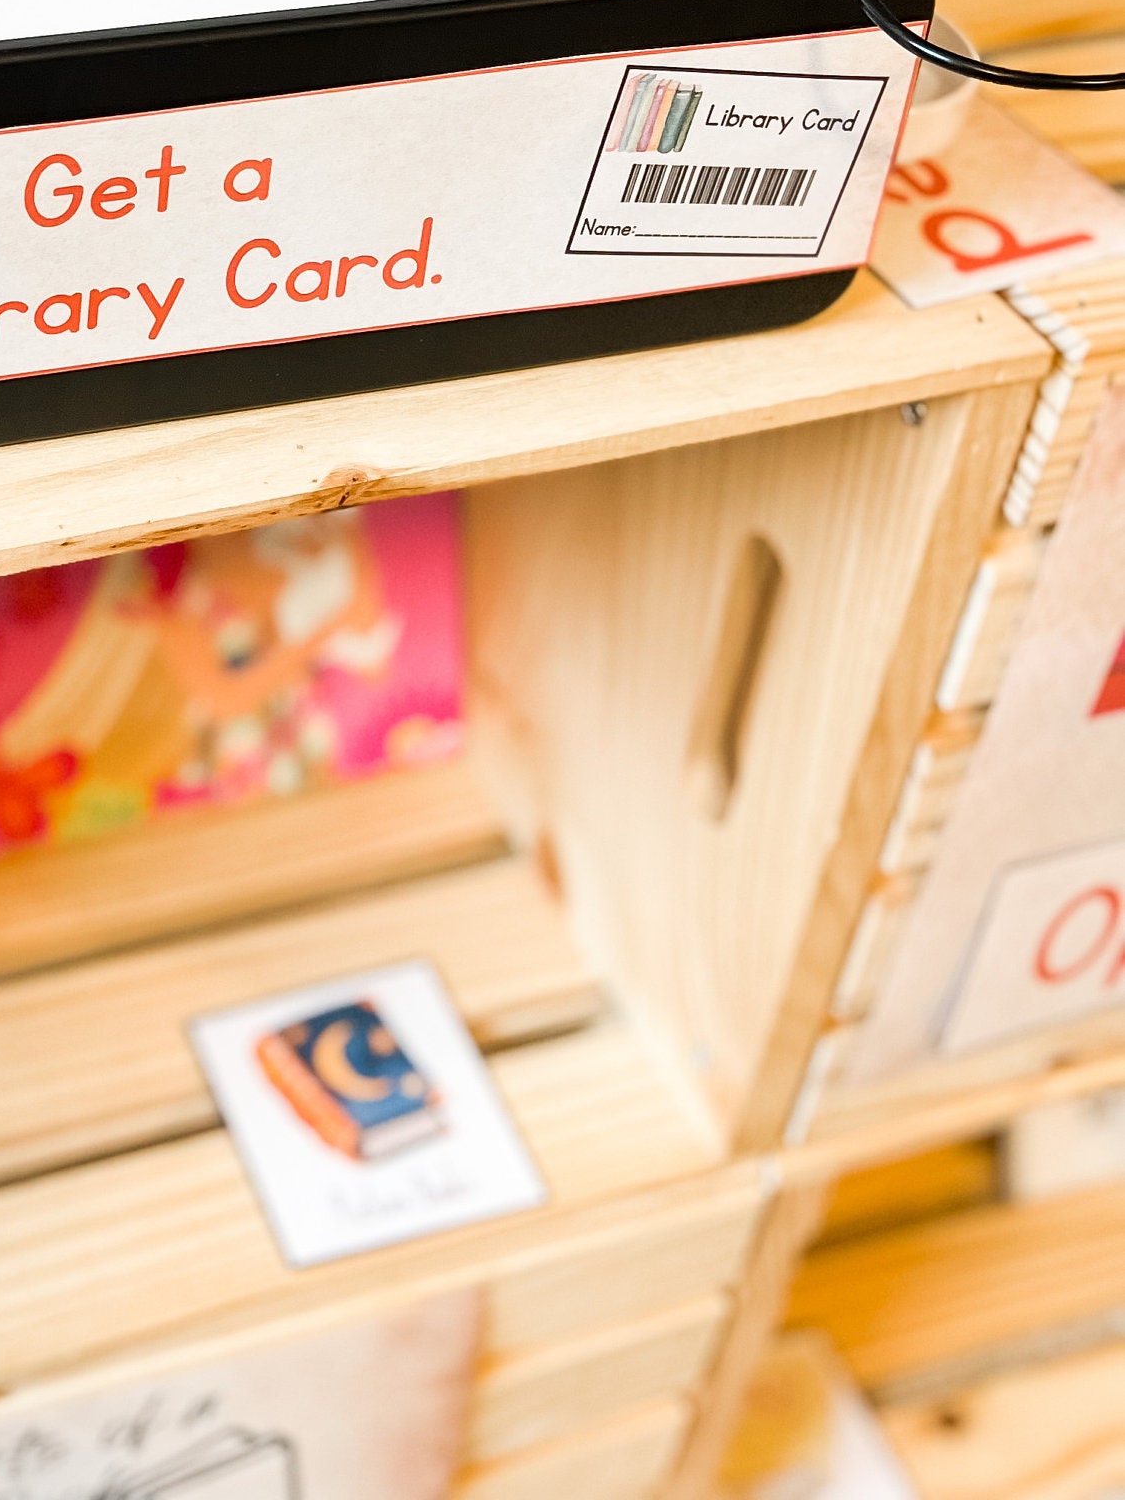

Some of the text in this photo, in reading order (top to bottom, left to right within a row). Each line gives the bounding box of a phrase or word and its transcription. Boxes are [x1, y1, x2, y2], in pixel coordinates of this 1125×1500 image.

[704, 103, 861, 135] Library Card
[24, 145, 272, 228] Get a
[580, 217, 637, 237] Name:
[226, 217, 442, 309] Card.
